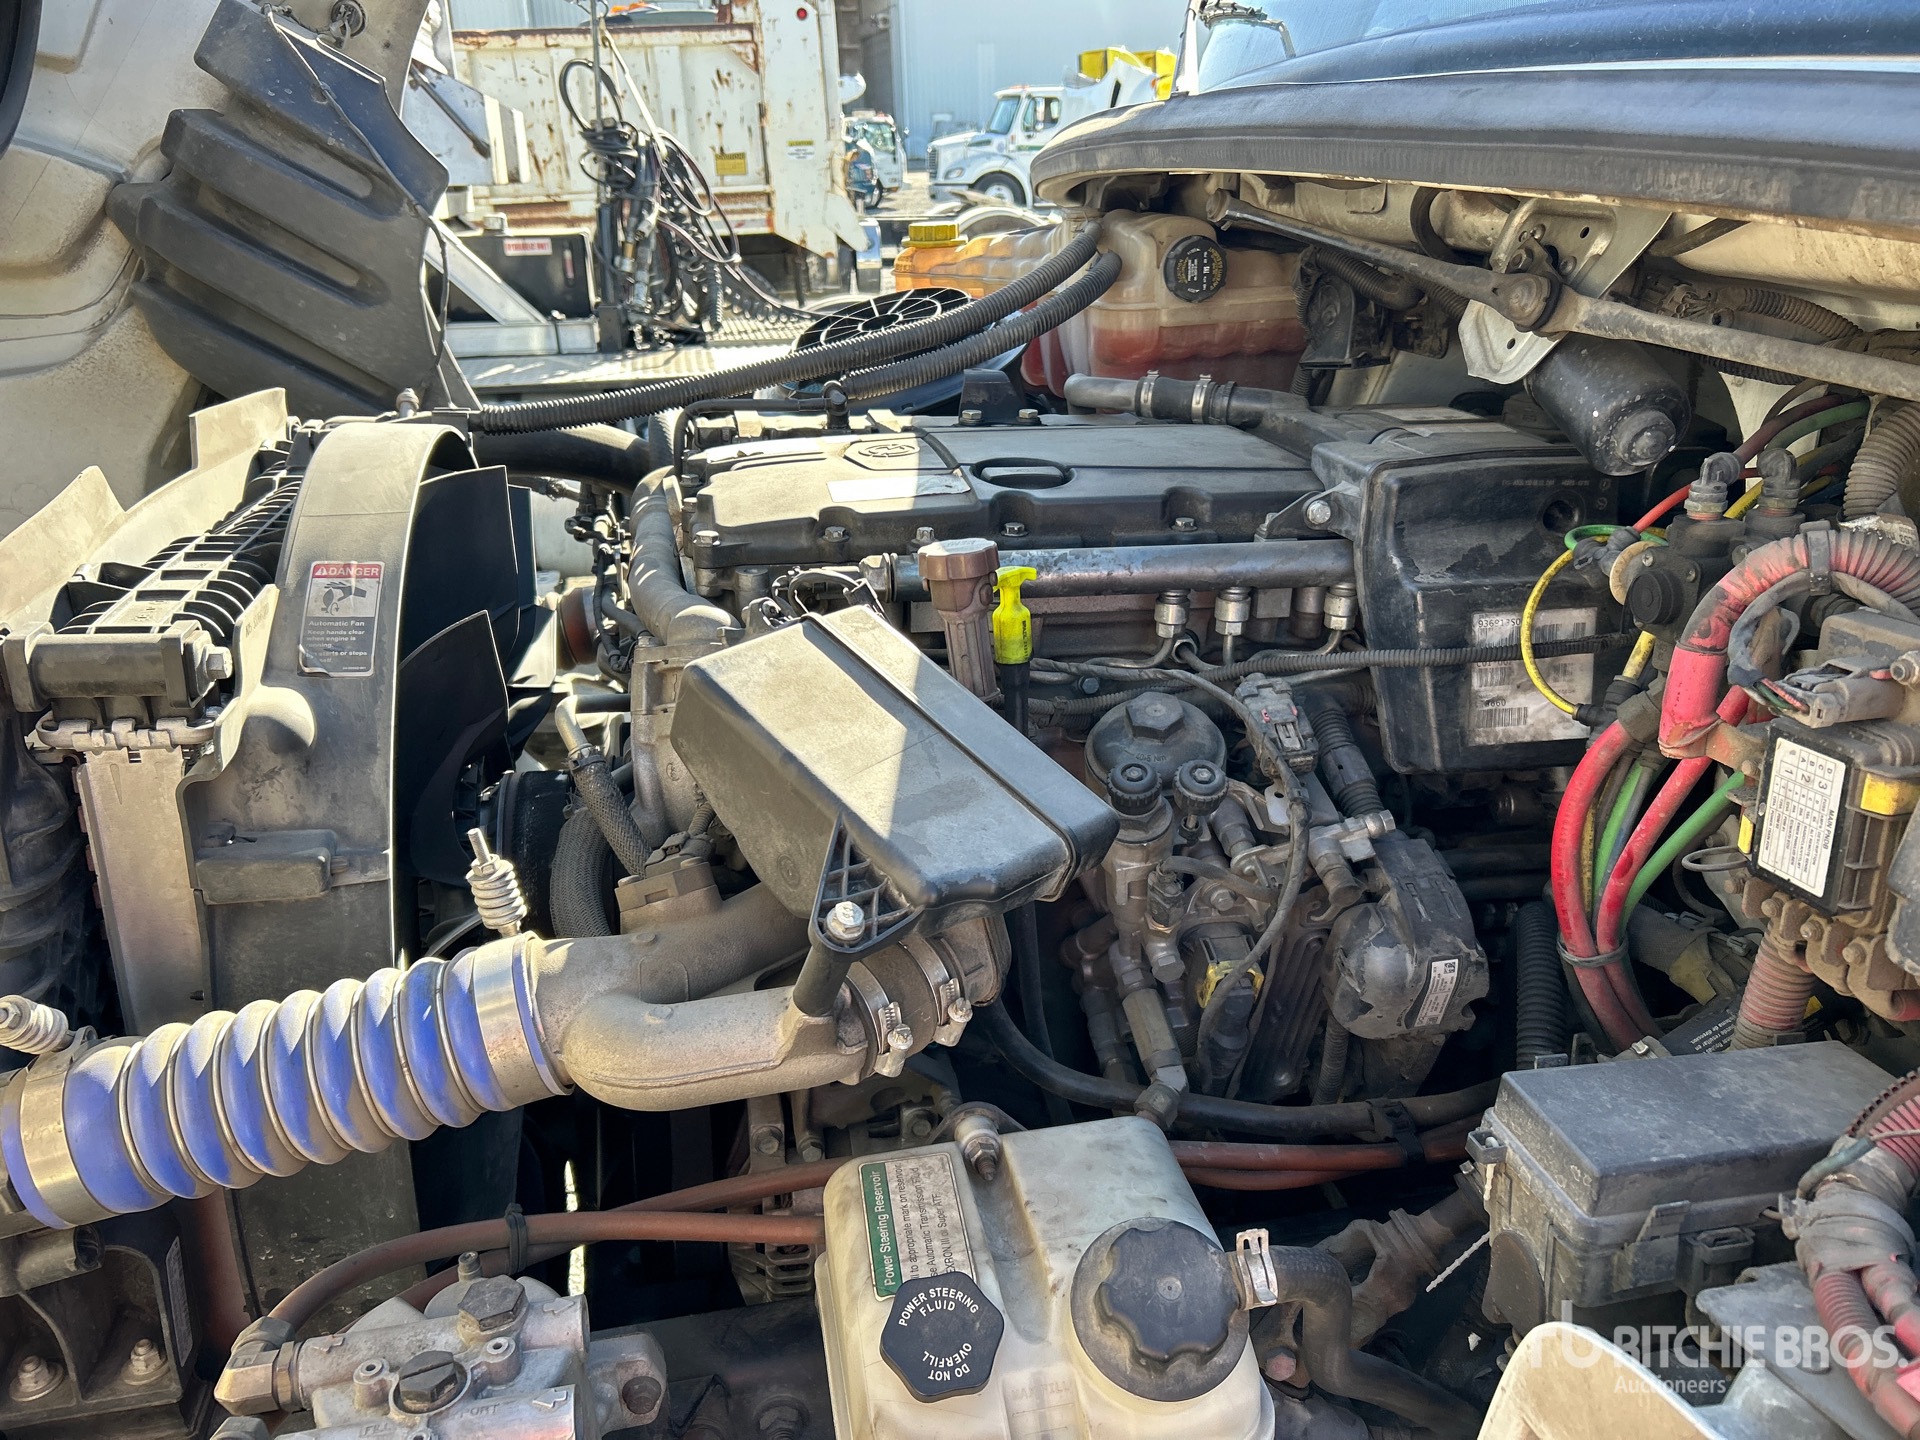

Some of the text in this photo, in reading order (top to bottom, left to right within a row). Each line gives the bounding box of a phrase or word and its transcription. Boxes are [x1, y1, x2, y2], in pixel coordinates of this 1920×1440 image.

[328, 568, 379, 576] DANGER
[1784, 767, 1793, 775] 1
[1800, 773, 1810, 783] 2
[1818, 780, 1827, 790] 3
[1822, 809, 1834, 850] MAIN PNDB
[1811, 831, 1821, 865] DESCRIPTION
[900, 1195, 908, 1203] on
[901, 1204, 910, 1222] mark
[938, 1207, 947, 1228] Super
[870, 1171, 896, 1286] Power Steering Reservoir
[910, 1168, 938, 1278] se Automatic Transmission Fluid
[904, 1223, 918, 1263] appropriate
[910, 1264, 918, 1272] to
[943, 1246, 956, 1272] EXRON
[899, 1288, 978, 1326] POWER STEERING
[920, 1300, 956, 1317] FLUID
[922, 1343, 972, 1368] OVERFILL
[928, 1364, 970, 1381] DO NOT
